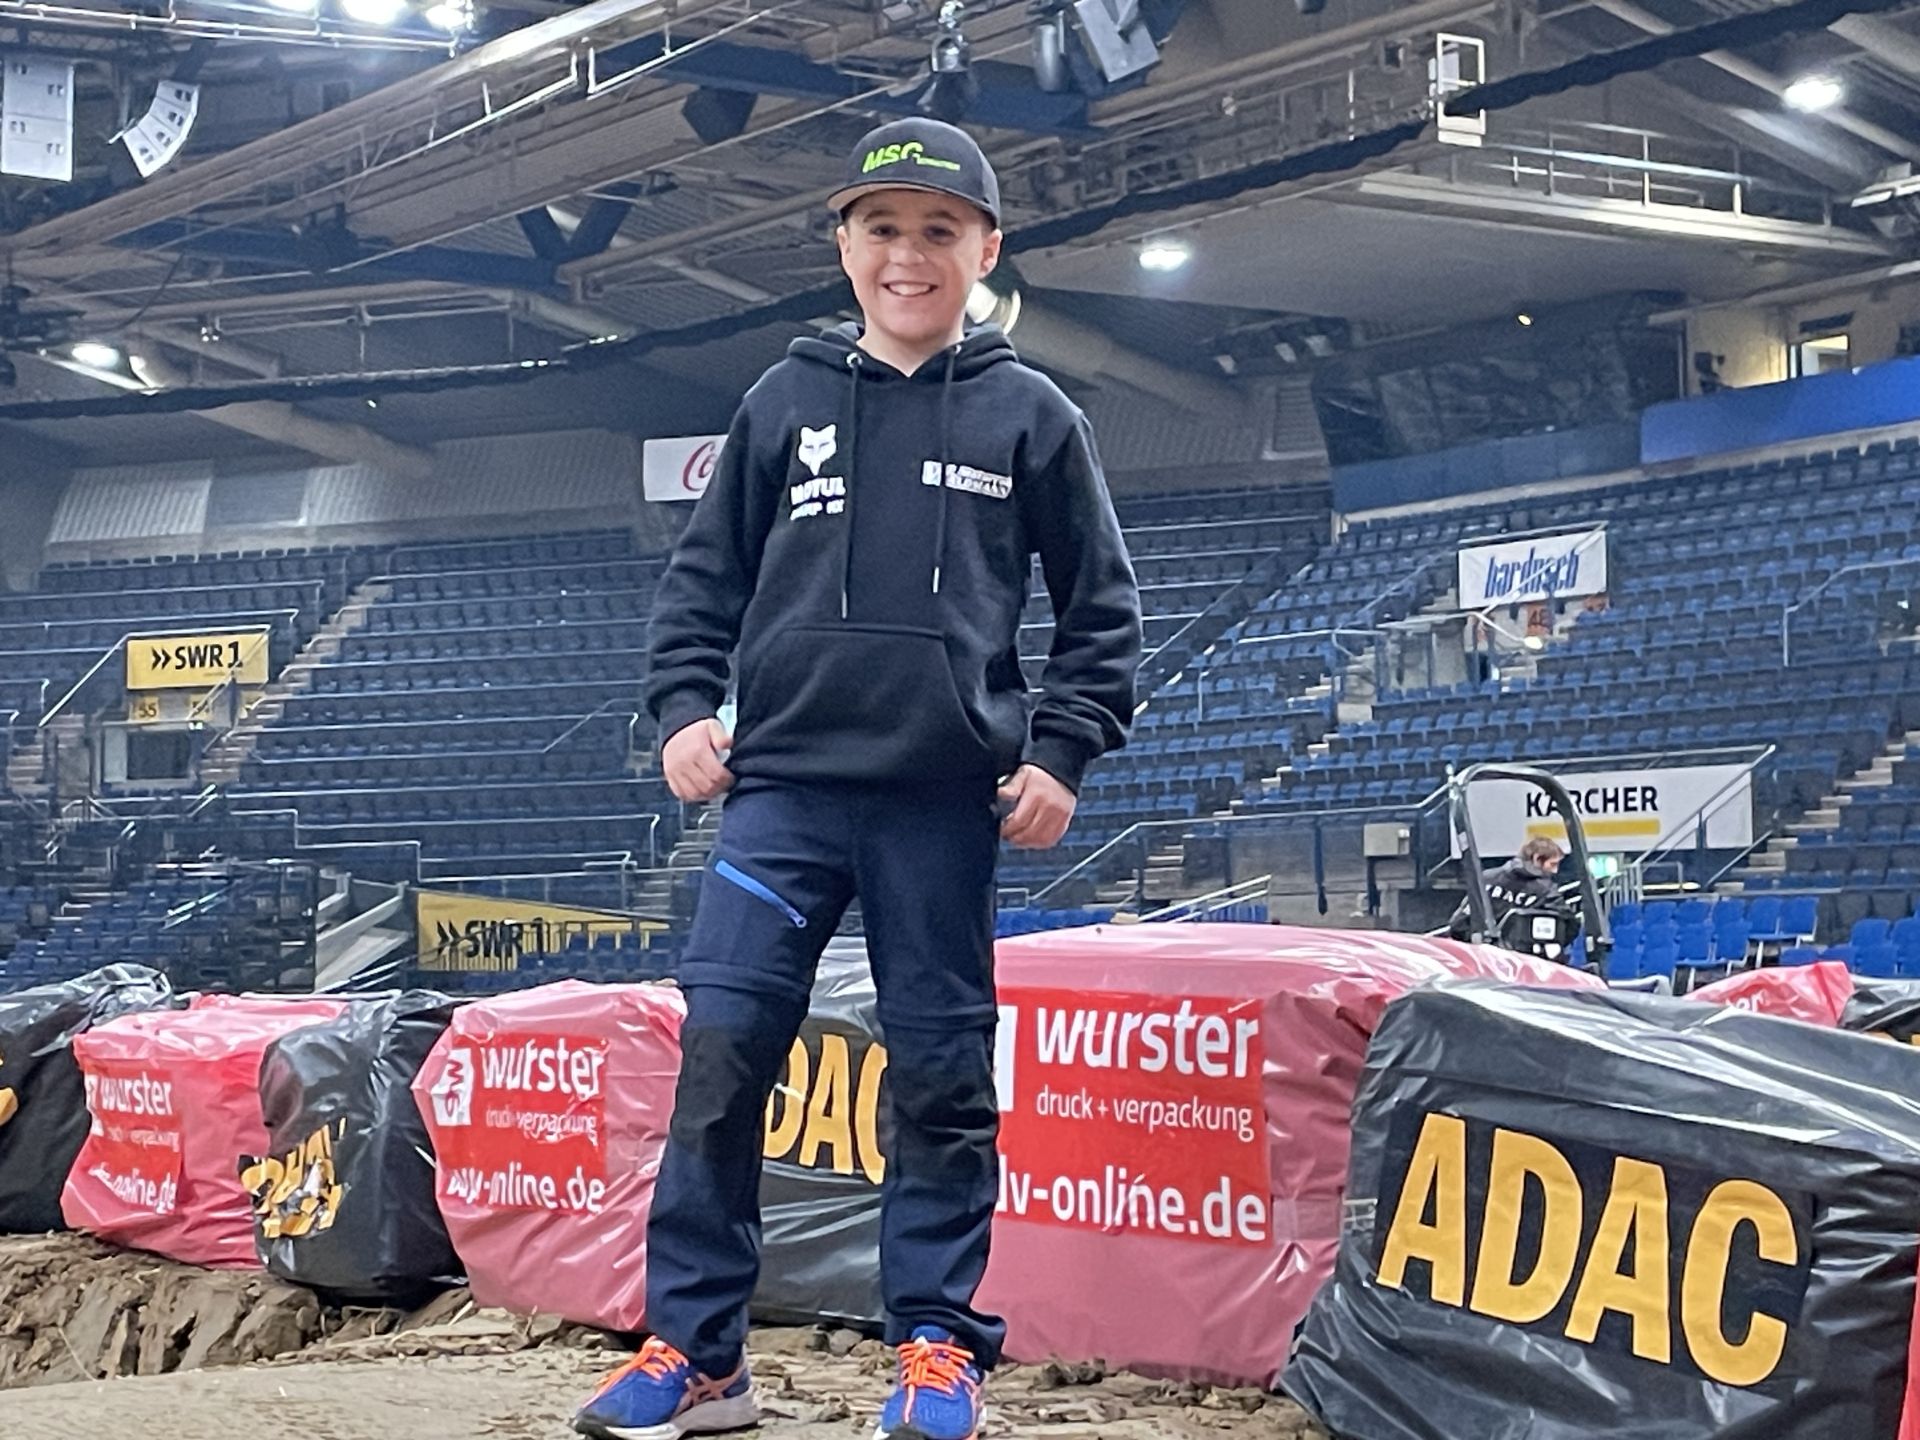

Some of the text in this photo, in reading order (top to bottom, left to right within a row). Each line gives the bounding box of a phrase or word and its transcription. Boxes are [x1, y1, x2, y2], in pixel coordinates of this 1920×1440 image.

[480, 1038, 605, 1099] wurster
[1037, 1000, 1259, 1078] wurster
[101, 1071, 173, 1115] wurster
[1036, 1084, 1094, 1119] druck
[1113, 1096, 1255, 1142] verpackung
[1375, 1112, 1798, 1386] ADAC
